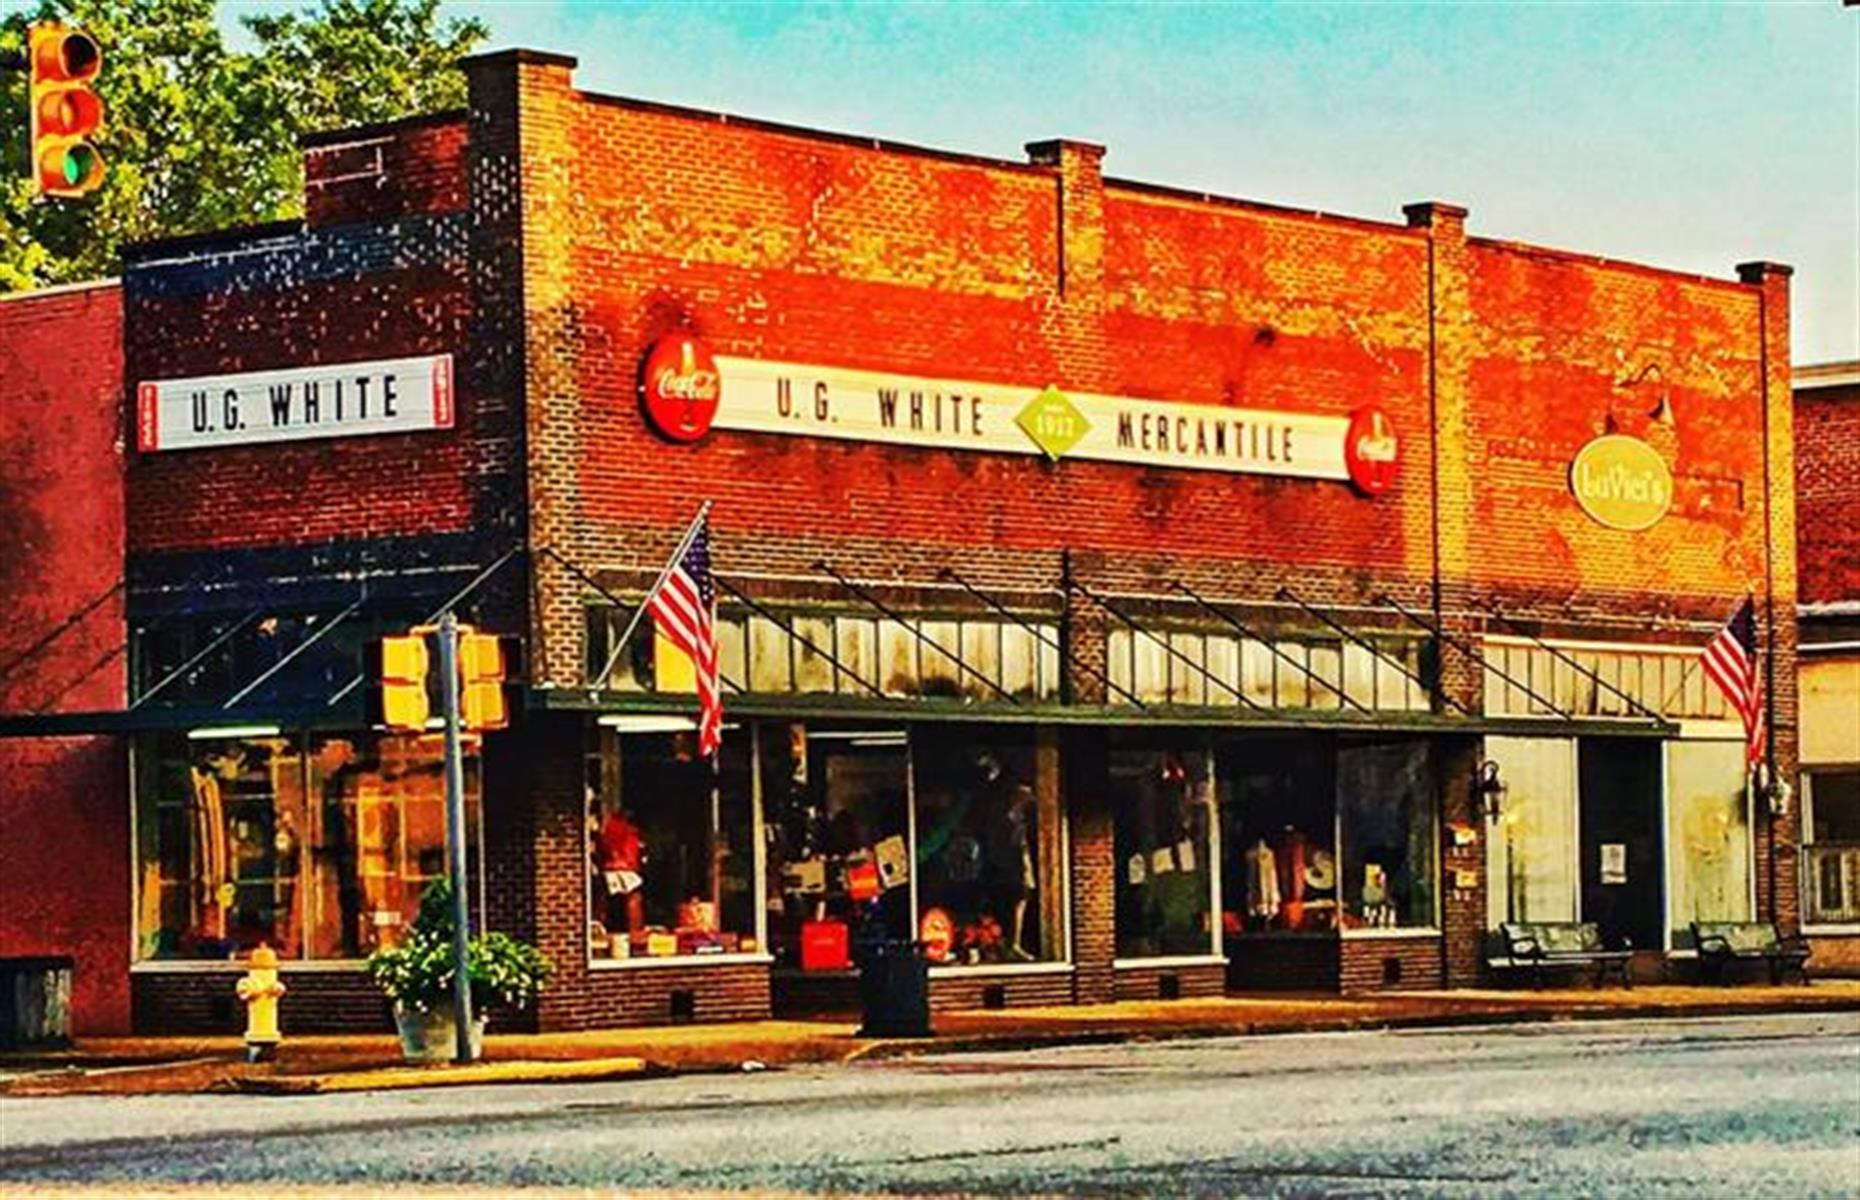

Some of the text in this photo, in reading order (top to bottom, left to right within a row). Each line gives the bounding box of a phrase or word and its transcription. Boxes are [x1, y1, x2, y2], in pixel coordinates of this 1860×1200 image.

[269, 375, 397, 426] WHITE
[878, 388, 983, 435] WHITE
[1117, 411, 1293, 463] MERCANTILE
